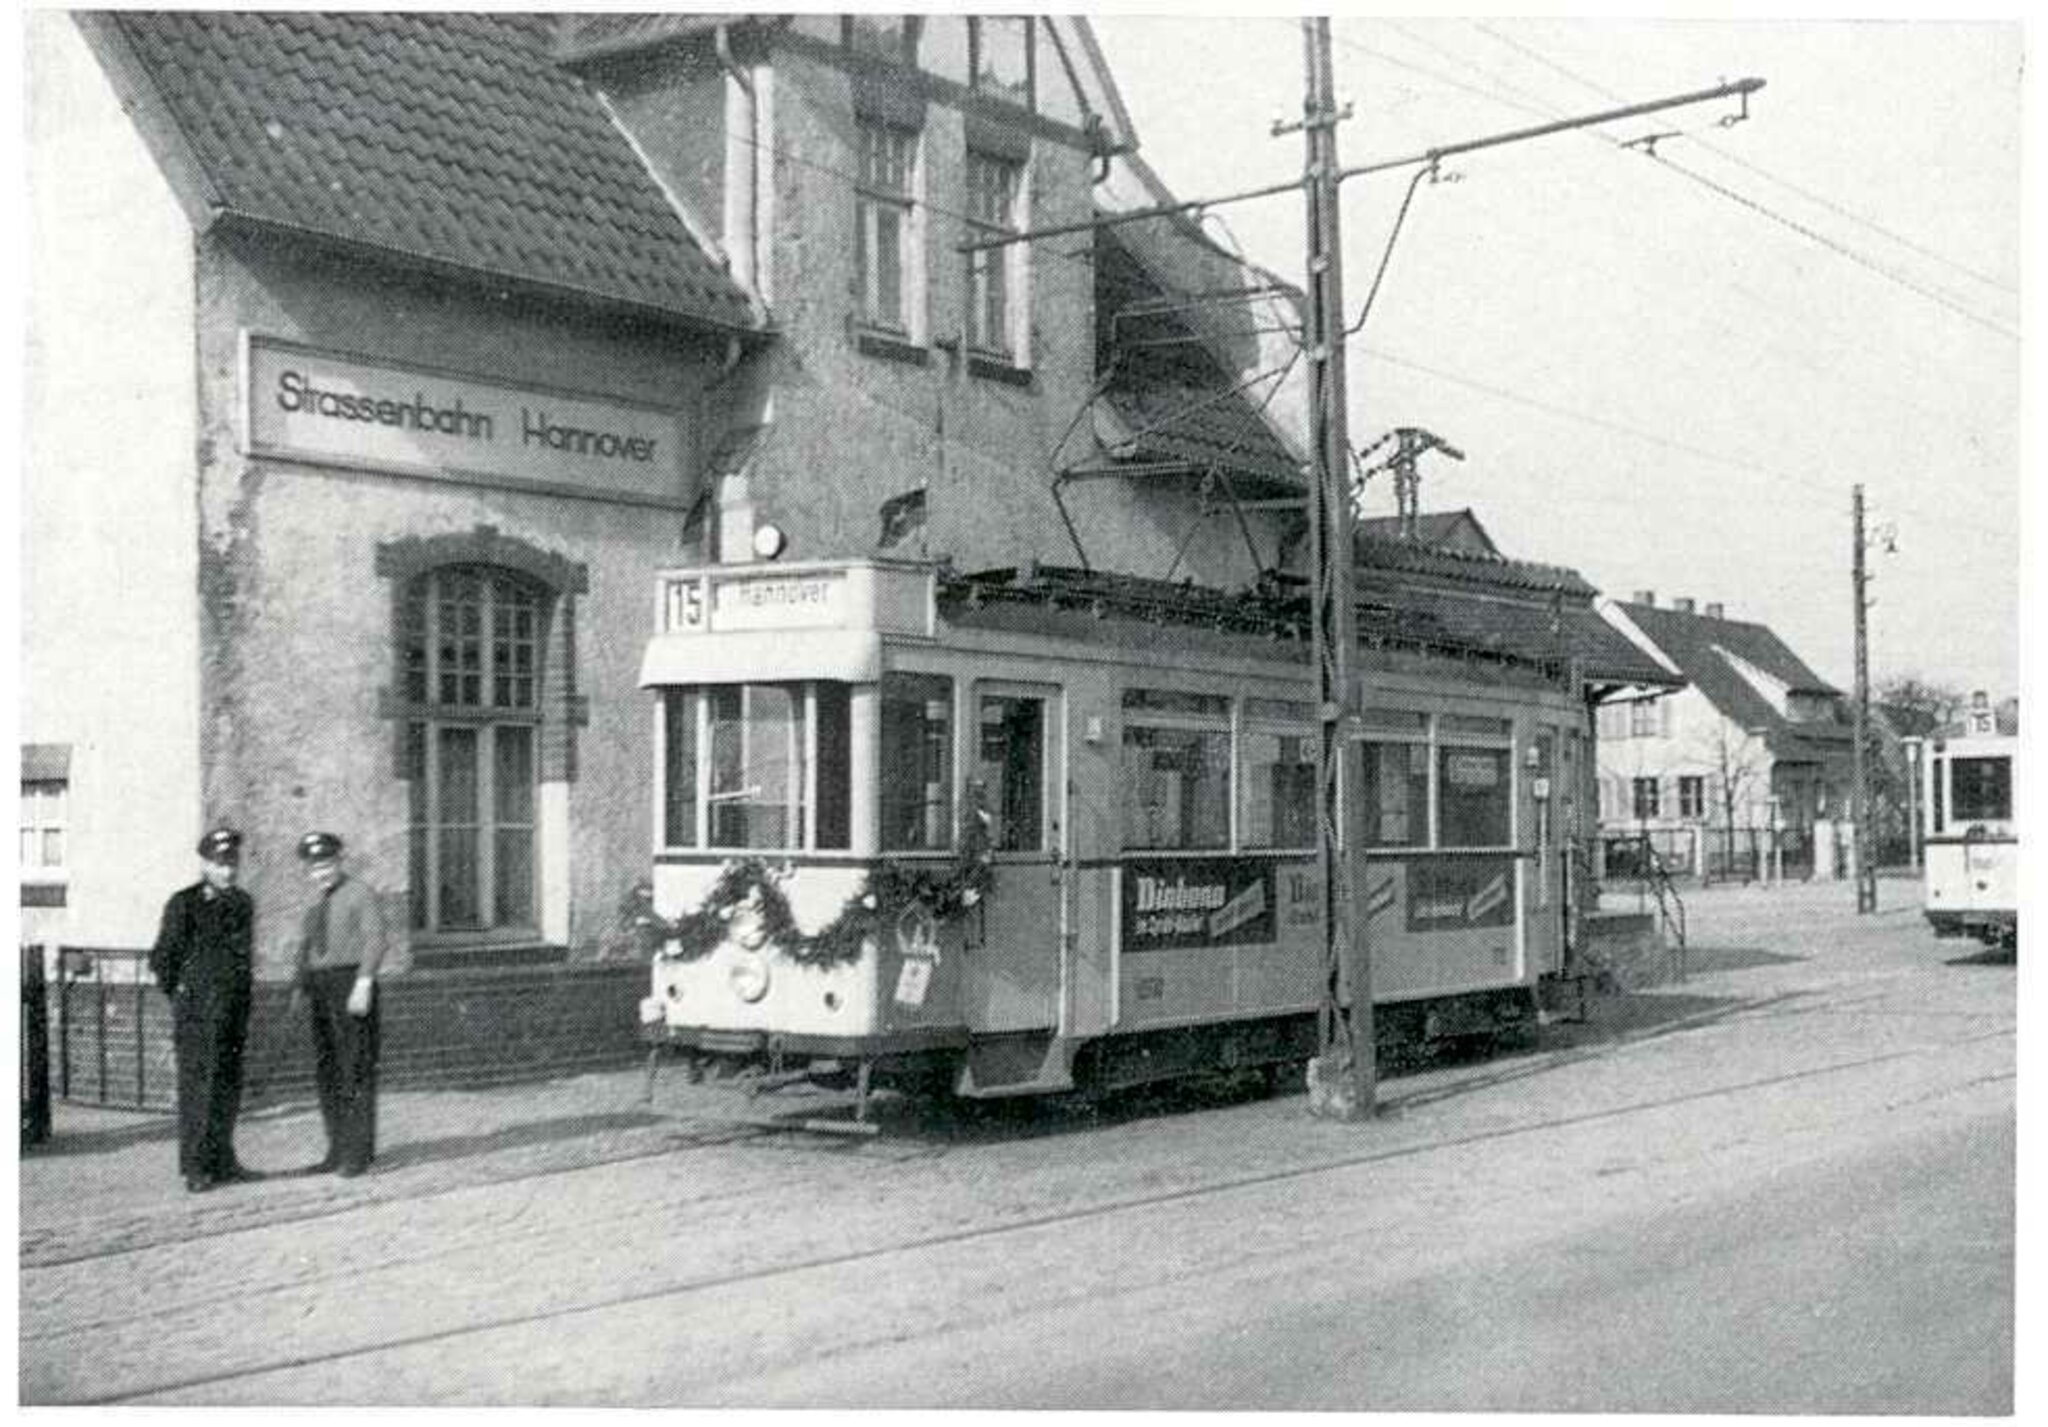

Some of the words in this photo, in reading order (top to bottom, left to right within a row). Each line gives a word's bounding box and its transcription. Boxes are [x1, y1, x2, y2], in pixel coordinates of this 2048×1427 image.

[278, 370, 493, 441] Strassenbahn
[522, 407, 658, 462] Hannover
[674, 581, 702, 626] 15
